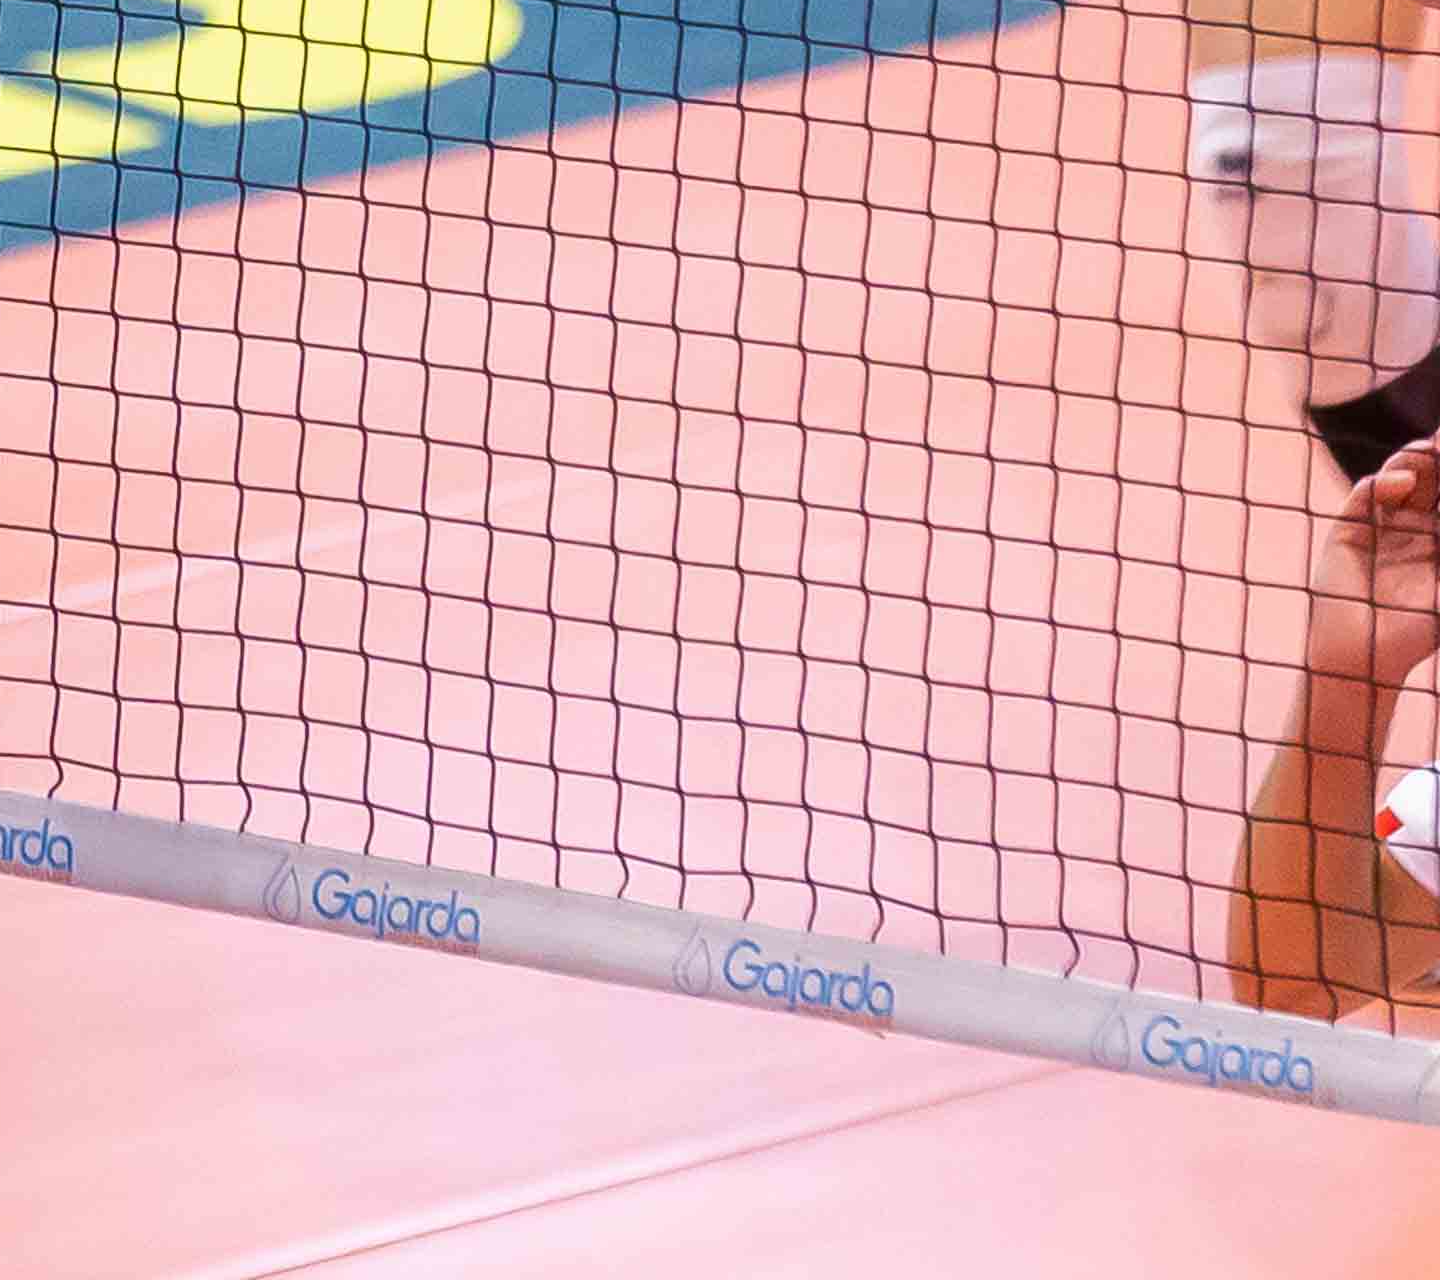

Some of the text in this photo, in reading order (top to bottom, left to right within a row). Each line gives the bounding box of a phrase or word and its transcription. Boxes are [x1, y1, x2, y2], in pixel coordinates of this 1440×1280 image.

[312, 868, 481, 944] Gajarda
[723, 938, 894, 1018] Gajarda
[1141, 1015, 1314, 1094] Gajarda
